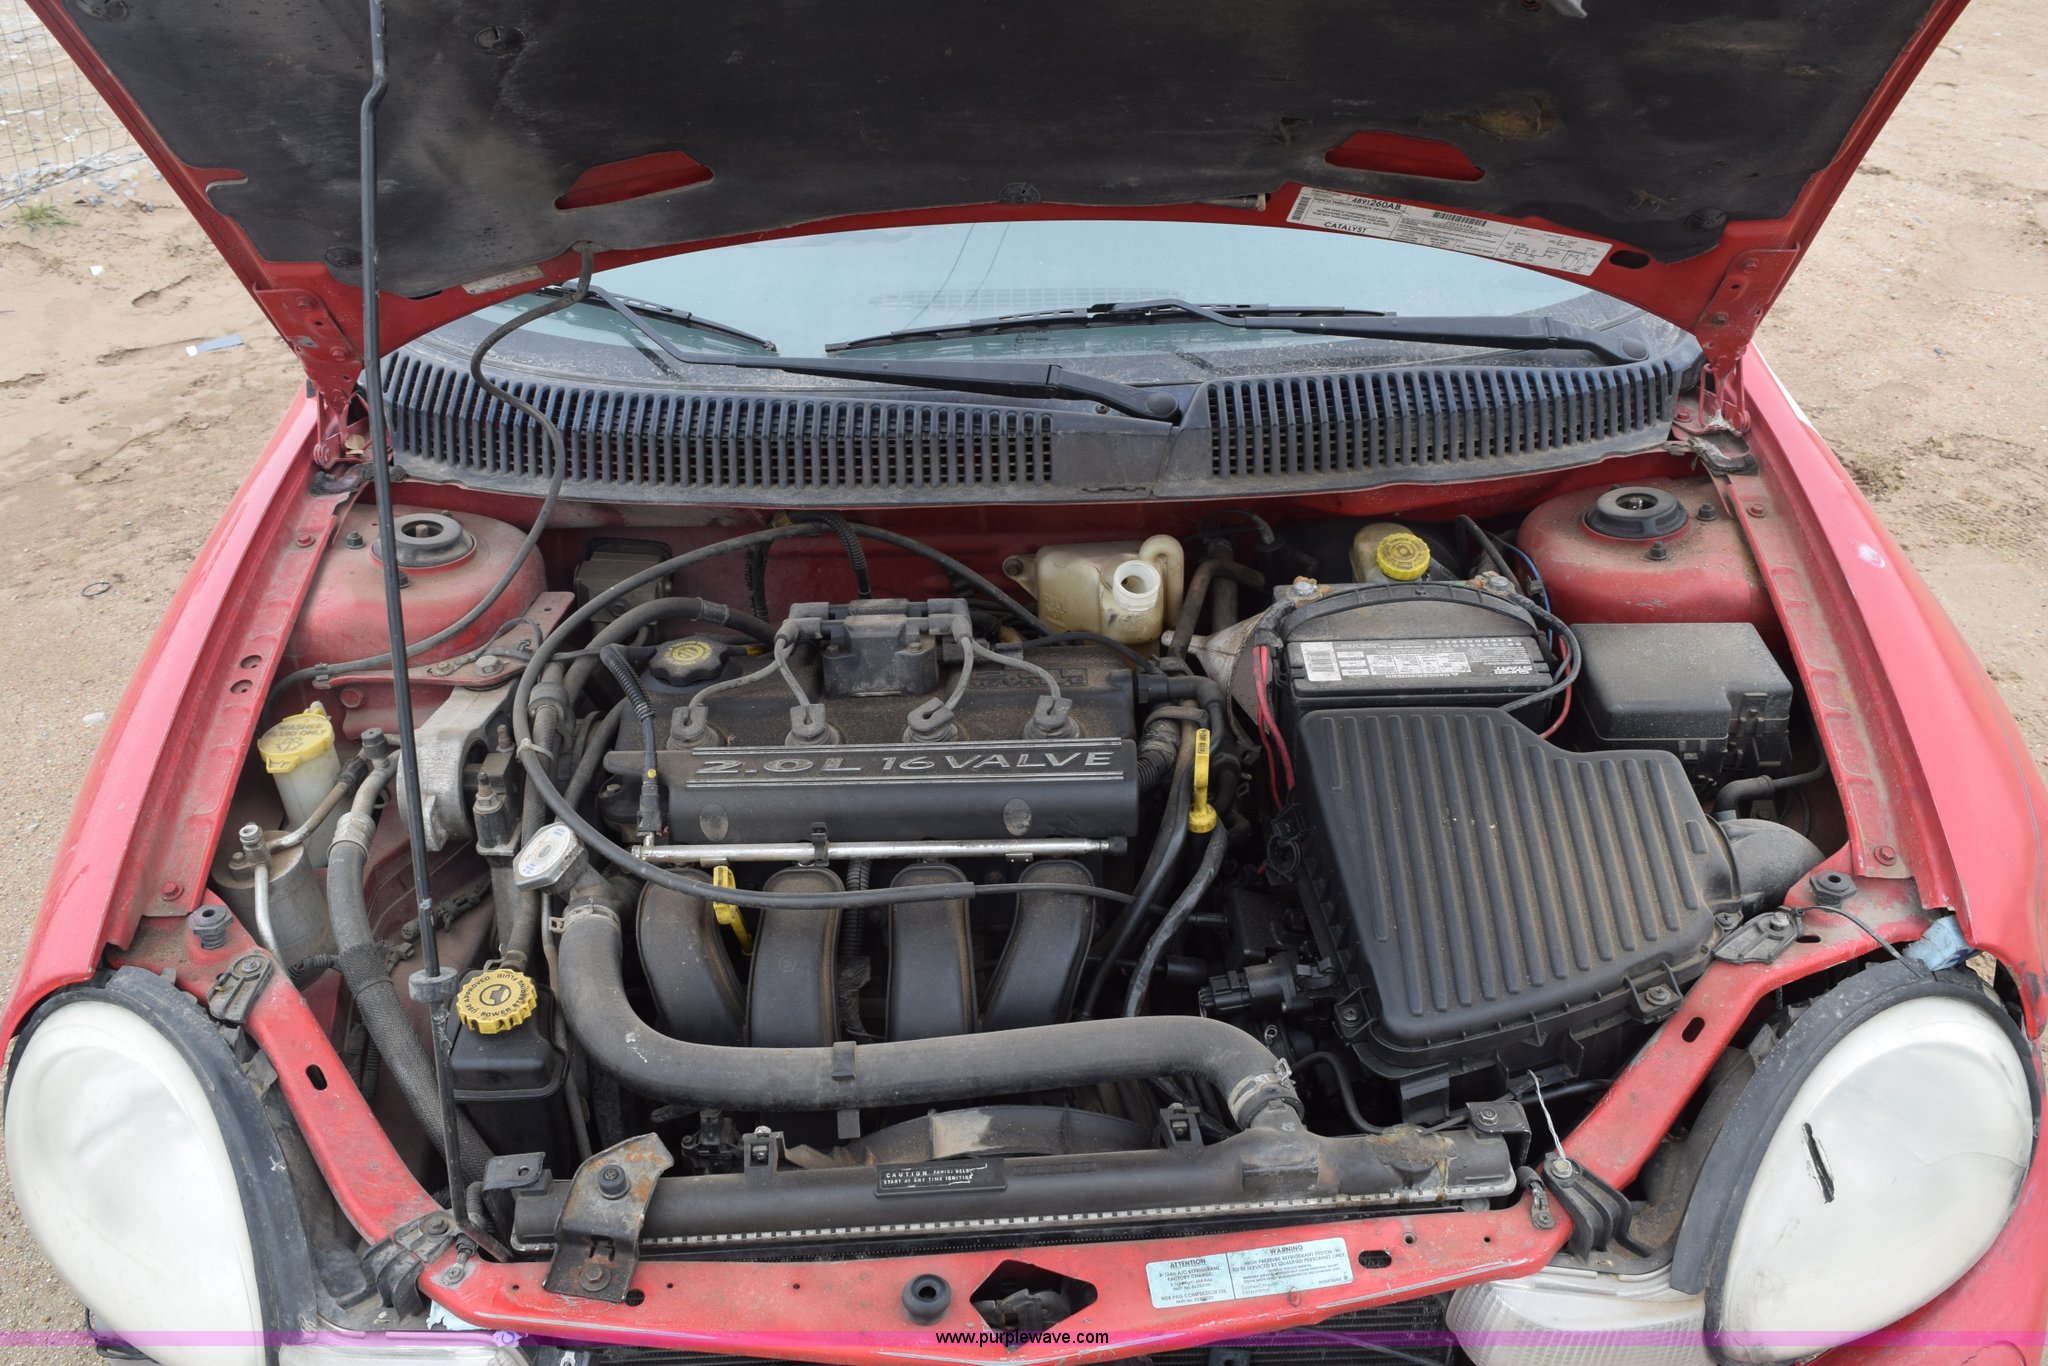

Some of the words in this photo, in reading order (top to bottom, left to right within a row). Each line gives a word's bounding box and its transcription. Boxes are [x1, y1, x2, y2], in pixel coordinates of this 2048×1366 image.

[1324, 222, 1366, 233] CATALYST
[695, 757, 861, 774] 2.0L
[880, 756, 936, 771] 16
[944, 751, 1115, 769] VALVE
[464, 976, 490, 1003] APPROVED
[480, 1007, 511, 1017] POWER
[496, 973, 519, 982] FLUID
[465, 1004, 478, 1014] USE
[1269, 1244, 1304, 1254] WARNING
[1169, 1258, 1206, 1268] ATTENTION
